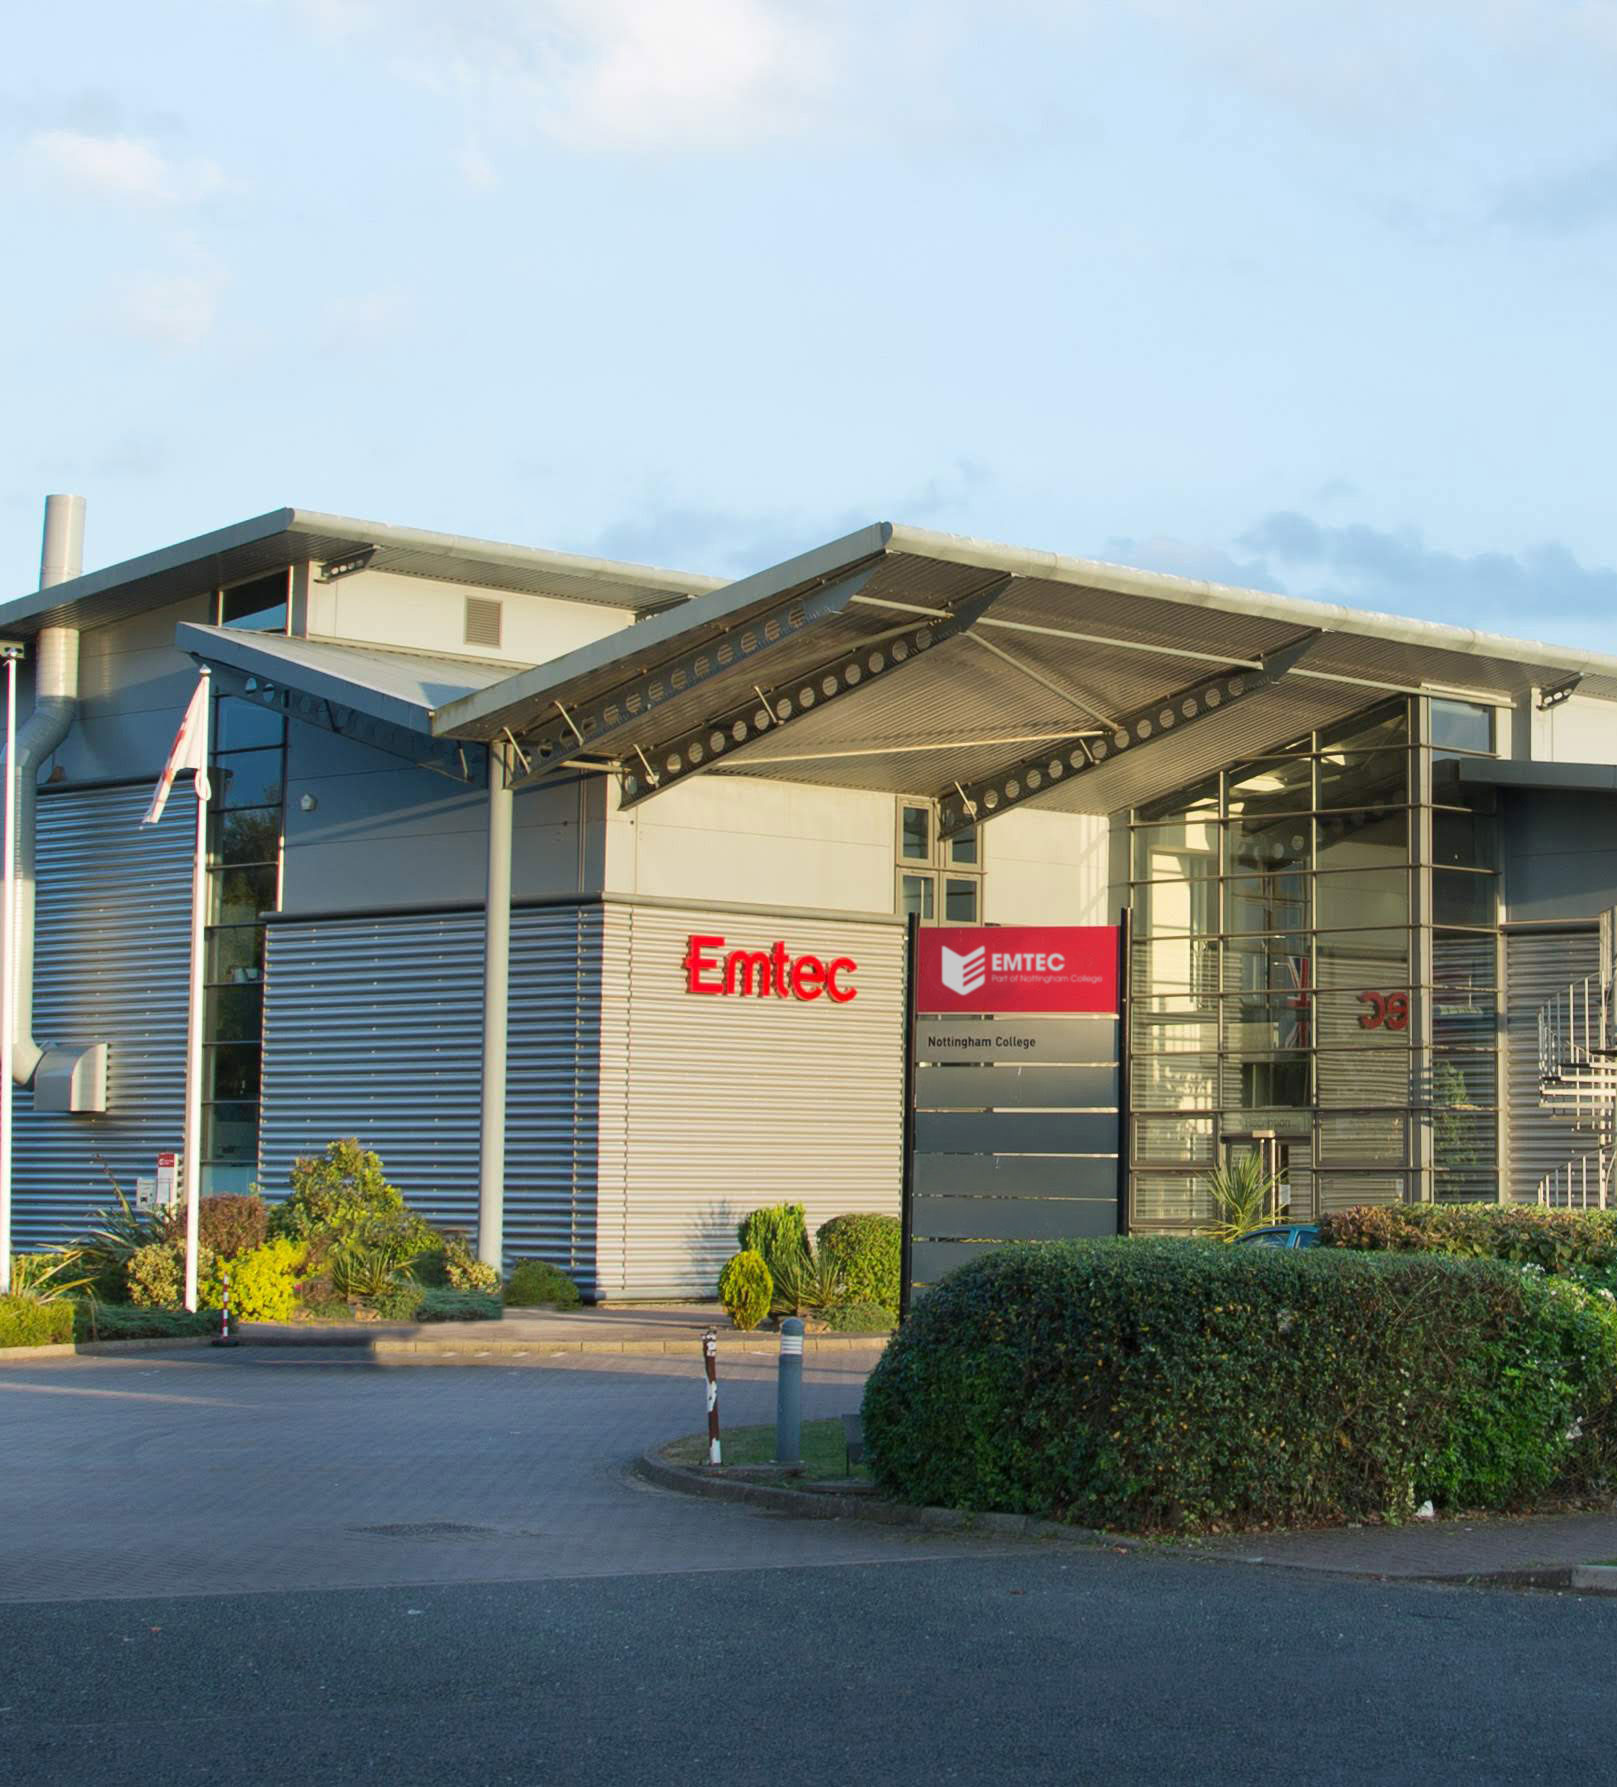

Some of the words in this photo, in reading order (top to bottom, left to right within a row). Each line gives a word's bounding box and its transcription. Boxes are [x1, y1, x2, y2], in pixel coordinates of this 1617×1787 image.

[681, 934, 858, 1003] Emtec
[991, 953, 1065, 972] EMTEC
[991, 974, 1008, 983] Part
[1010, 974, 1019, 983] of
[1020, 974, 1069, 985] Nottingham
[1070, 974, 1103, 985] College
[927, 1036, 992, 1049] Nottingham
[995, 1036, 1037, 1049] College
